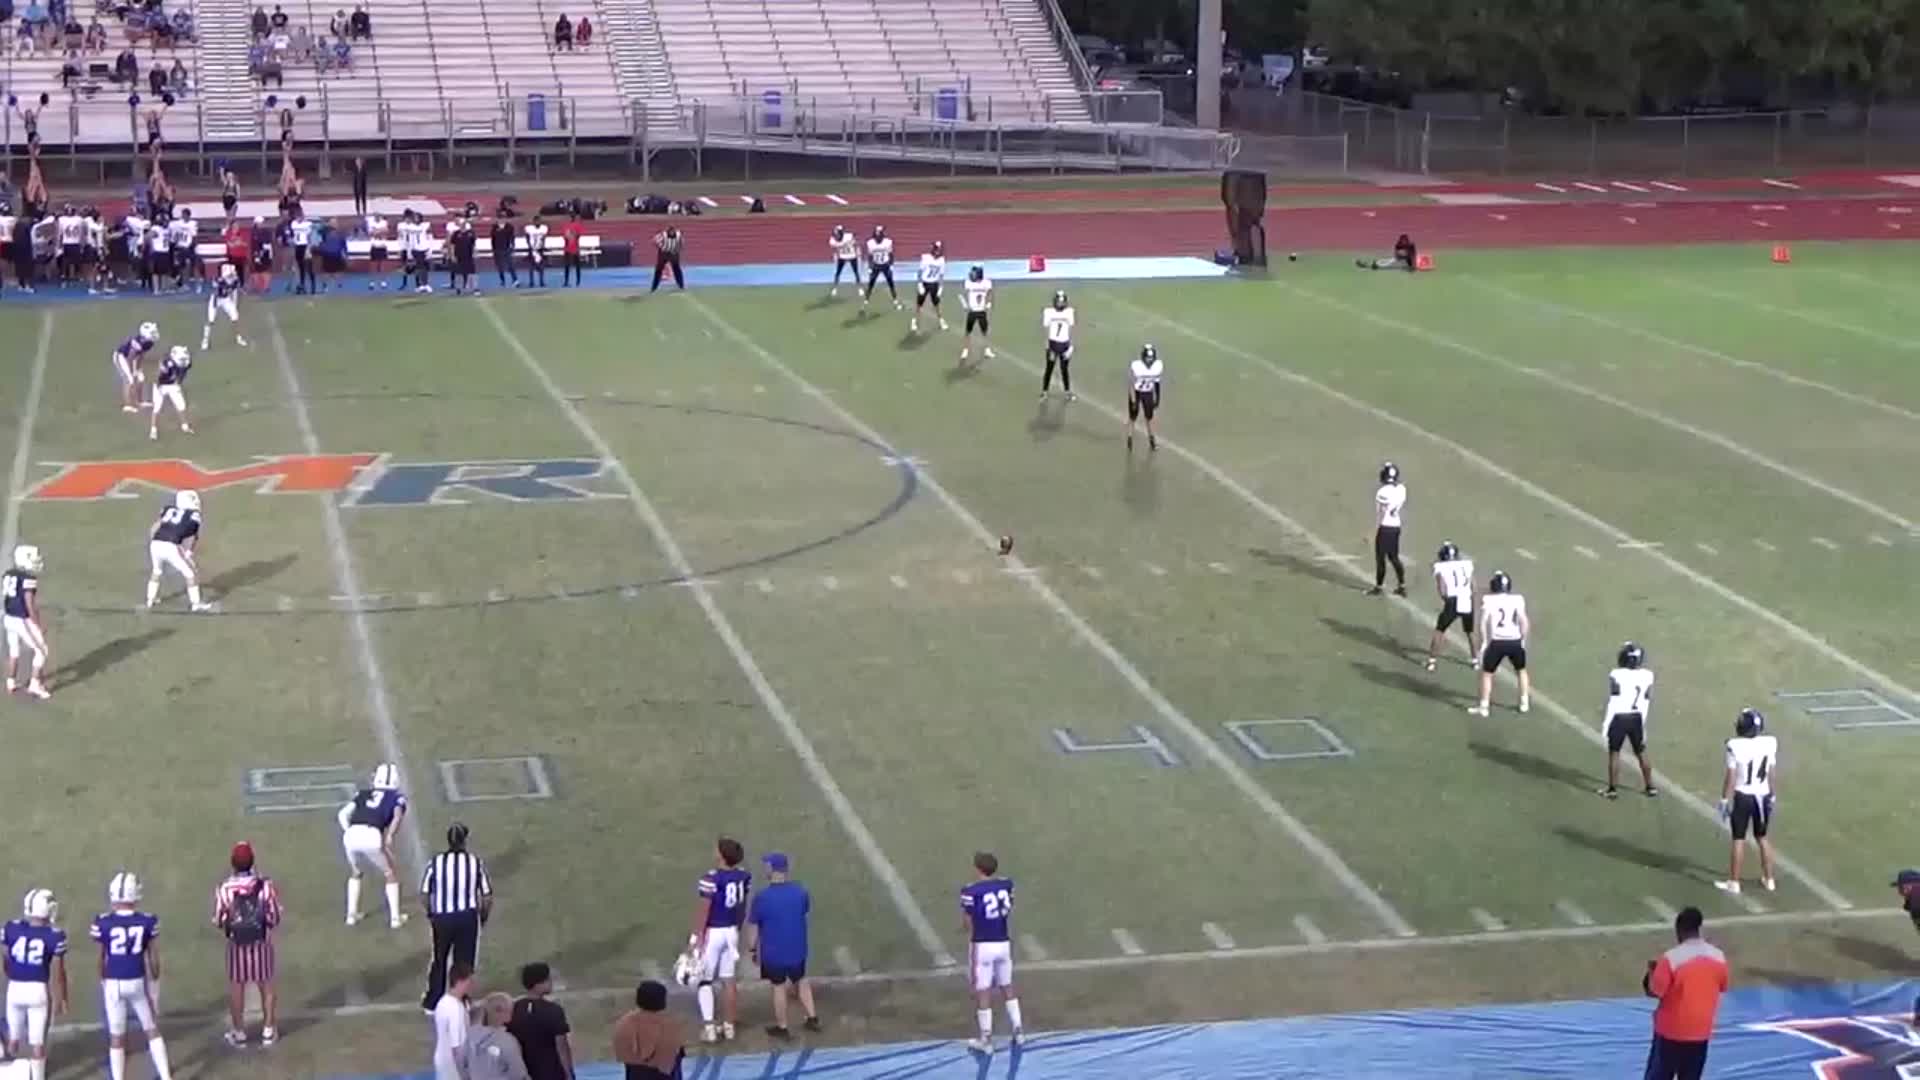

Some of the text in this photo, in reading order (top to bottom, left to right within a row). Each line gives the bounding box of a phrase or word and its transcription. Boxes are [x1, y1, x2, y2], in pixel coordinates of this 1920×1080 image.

[16, 452, 630, 508] MR
[1050, 715, 1355, 766] 40
[245, 755, 556, 815] 50
[1745, 755, 1769, 786] 14
[365, 790, 384, 809] 3
[724, 882, 745, 908] 81
[982, 888, 1011, 920] 23
[10, 935, 45, 965] 42
[110, 925, 145, 955] 27
